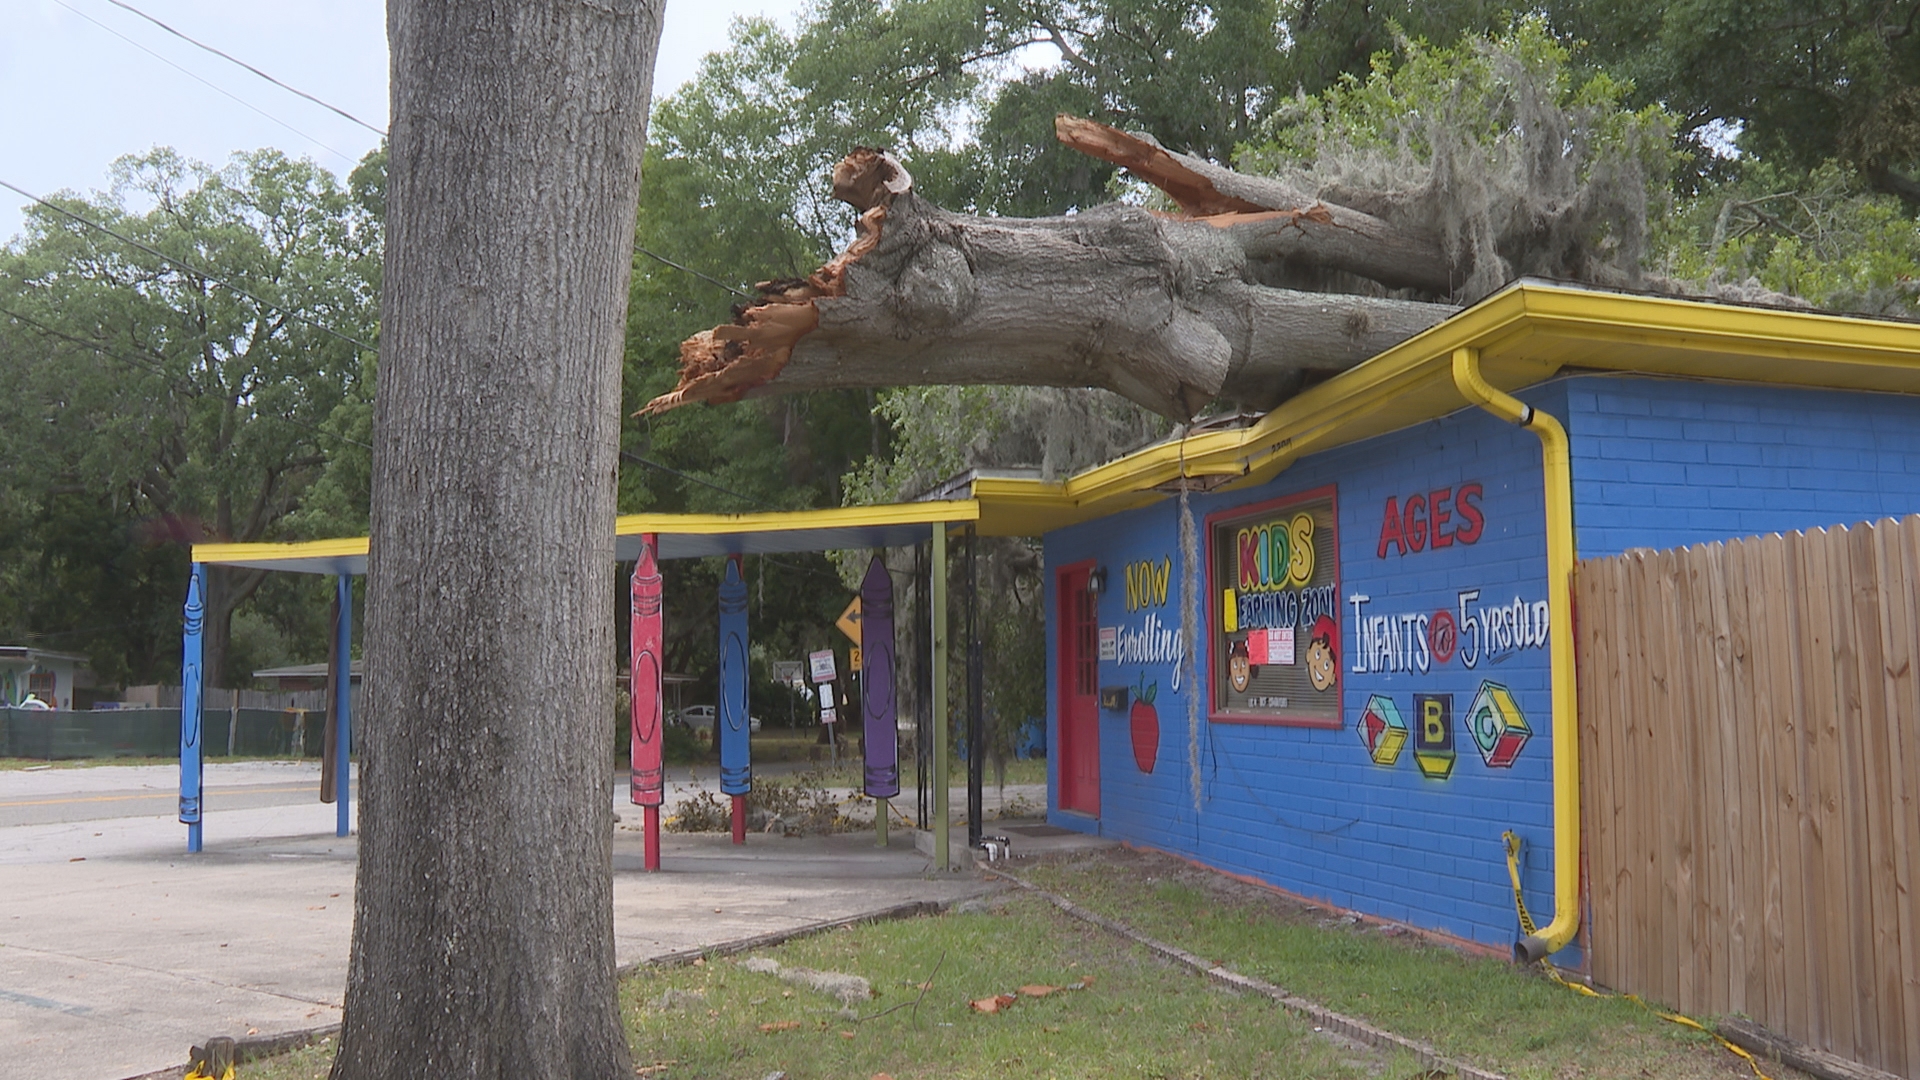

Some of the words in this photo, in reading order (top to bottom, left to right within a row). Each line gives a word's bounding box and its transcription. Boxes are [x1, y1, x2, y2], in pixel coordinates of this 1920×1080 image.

[1237, 513, 1314, 592] KIDS
[1377, 484, 1484, 559] AGES
[1124, 554, 1171, 613] NOW
[1237, 591, 1298, 629] EARNING
[1117, 611, 1185, 693] Enrolling
[1350, 592, 1430, 675] INFANTS
[1458, 588, 1480, 669] 5
[1423, 698, 1445, 743] B
[1474, 705, 1497, 751] C
